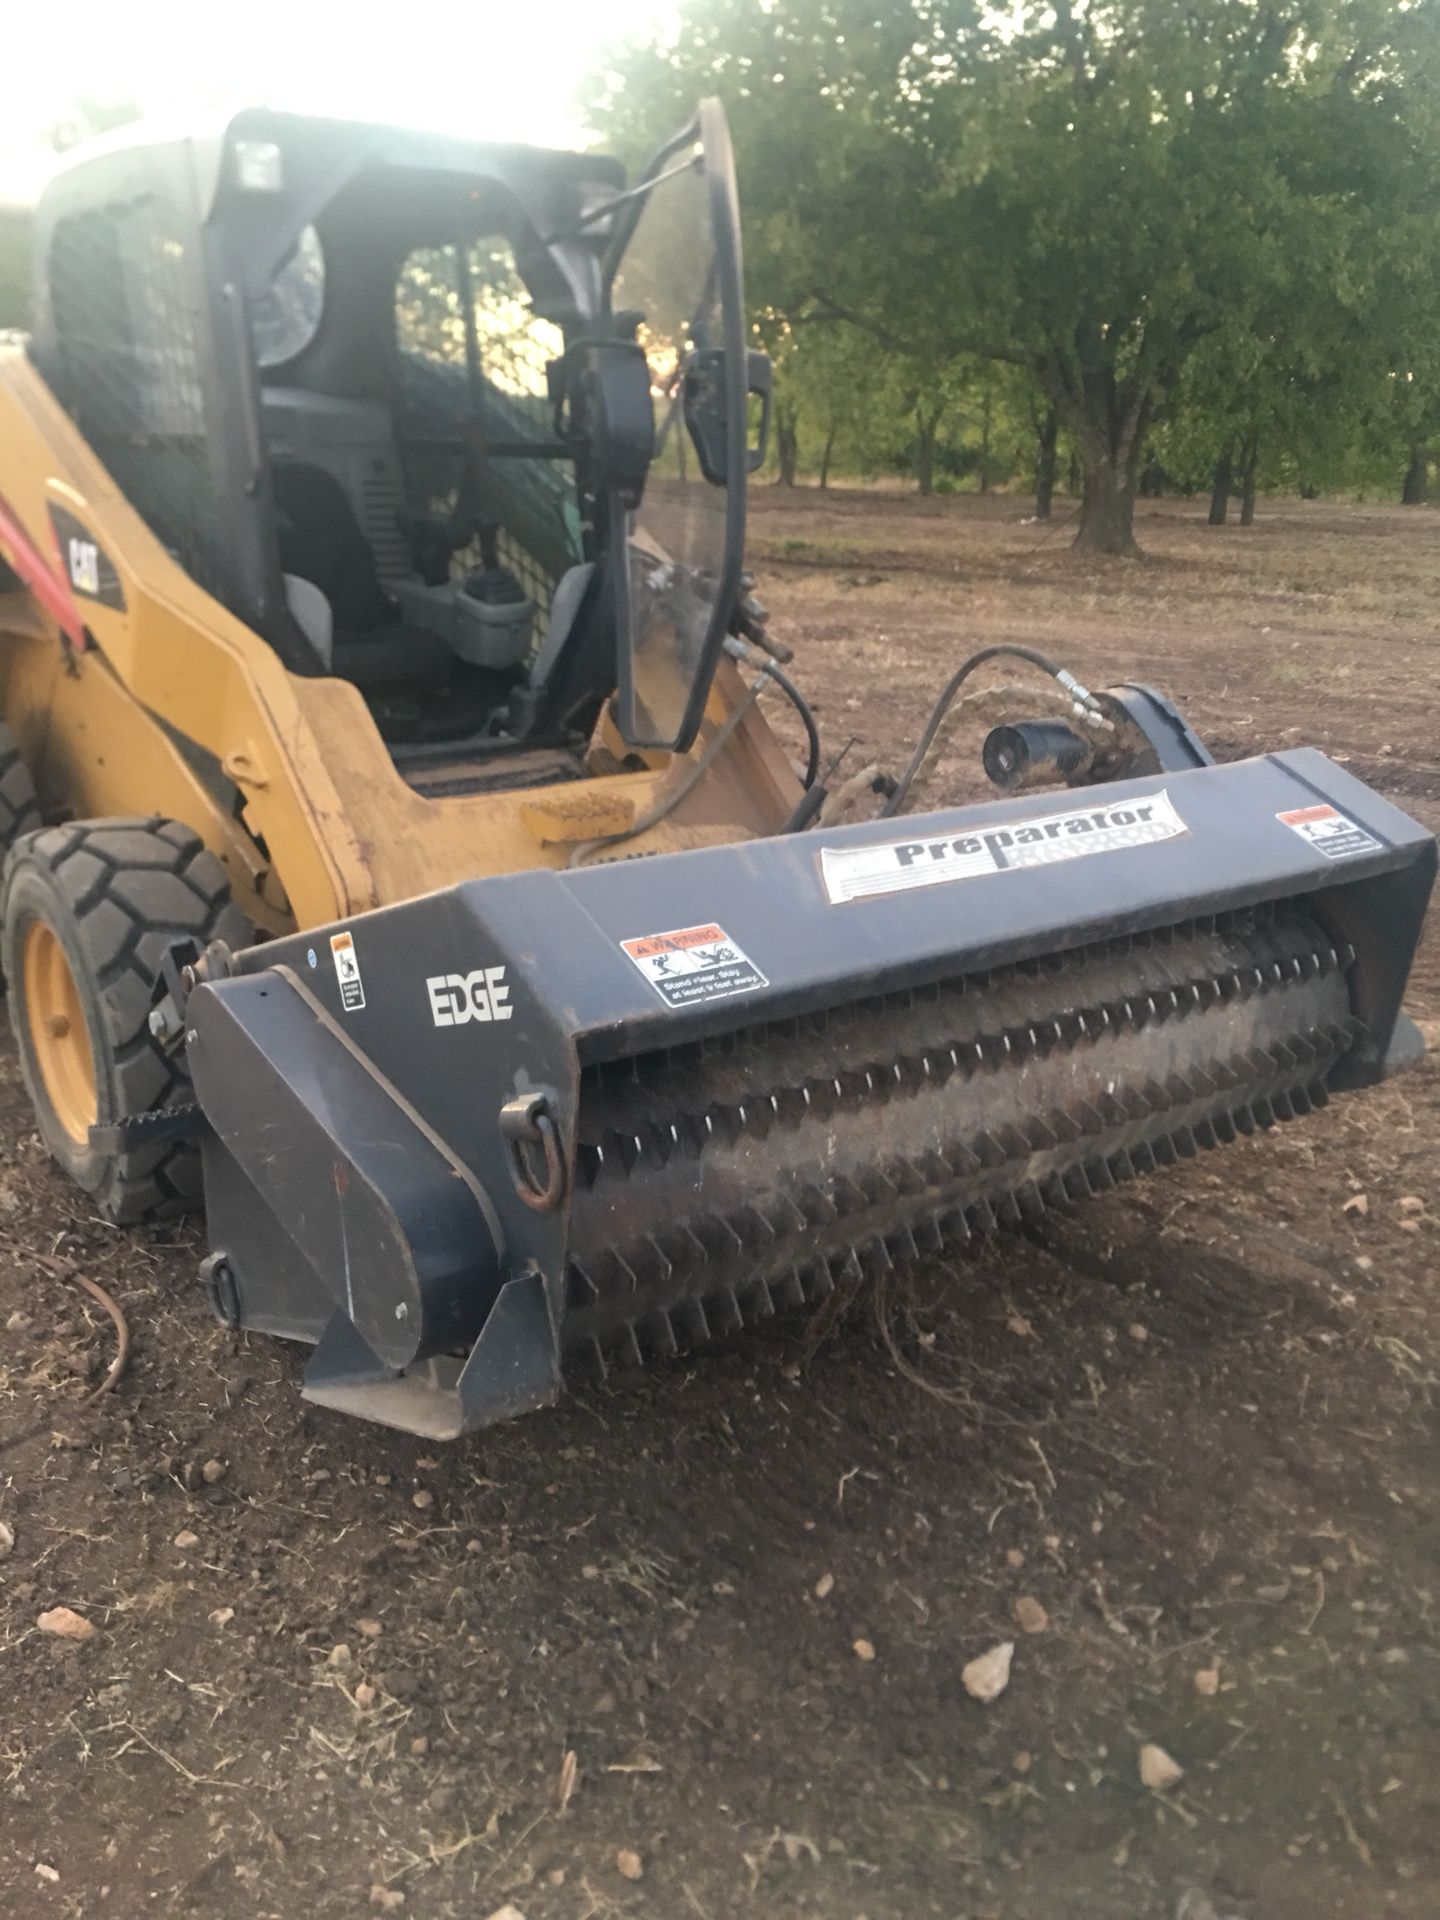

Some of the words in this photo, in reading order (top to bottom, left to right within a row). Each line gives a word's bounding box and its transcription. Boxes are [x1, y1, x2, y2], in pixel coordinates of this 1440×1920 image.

[69, 538, 99, 594] CAT
[894, 803, 1154, 869] Preparator
[426, 965, 513, 1027] EDGE
[664, 978, 692, 991] Stand
[718, 969, 741, 979] Stay
[671, 991, 682, 1000] at
[681, 986, 706, 997] least
